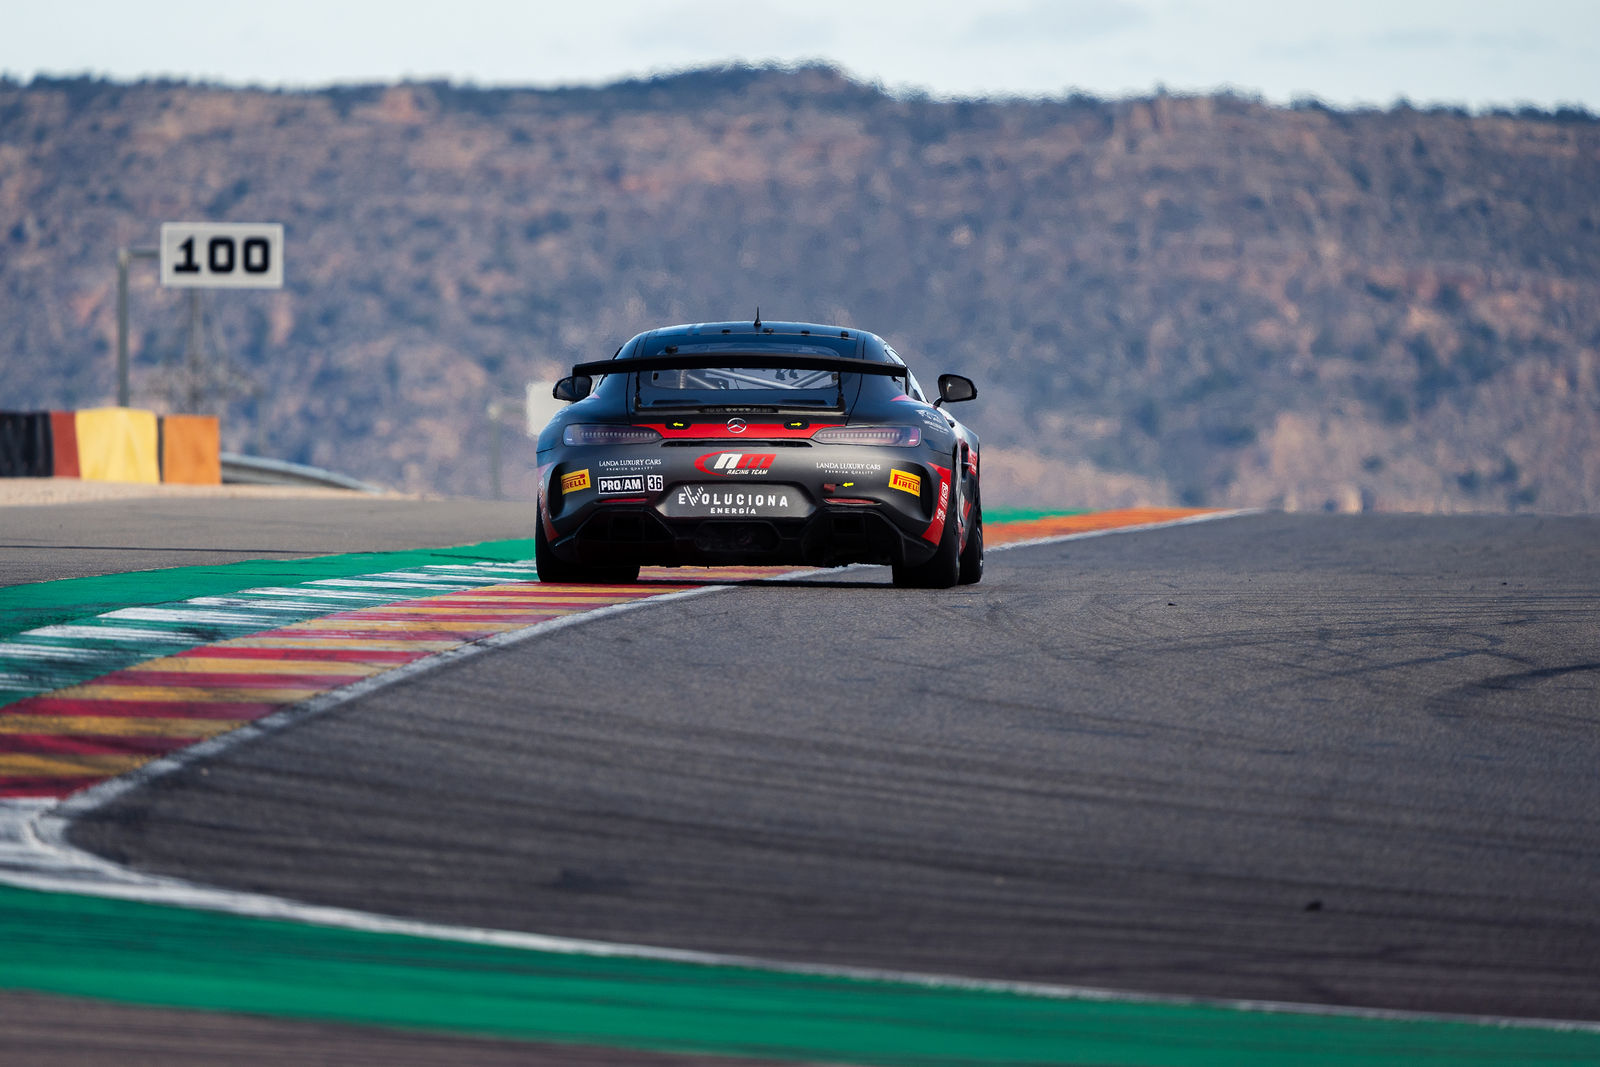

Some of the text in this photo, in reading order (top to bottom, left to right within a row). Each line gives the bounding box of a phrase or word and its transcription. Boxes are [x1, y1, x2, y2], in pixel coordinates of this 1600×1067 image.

[174, 236, 270, 273] 100
[600, 479, 642, 491] PRO/AM
[649, 477, 662, 490] 36
[678, 485, 789, 507] EVOLUCIONA
[710, 507, 757, 515] ENERGÍA
